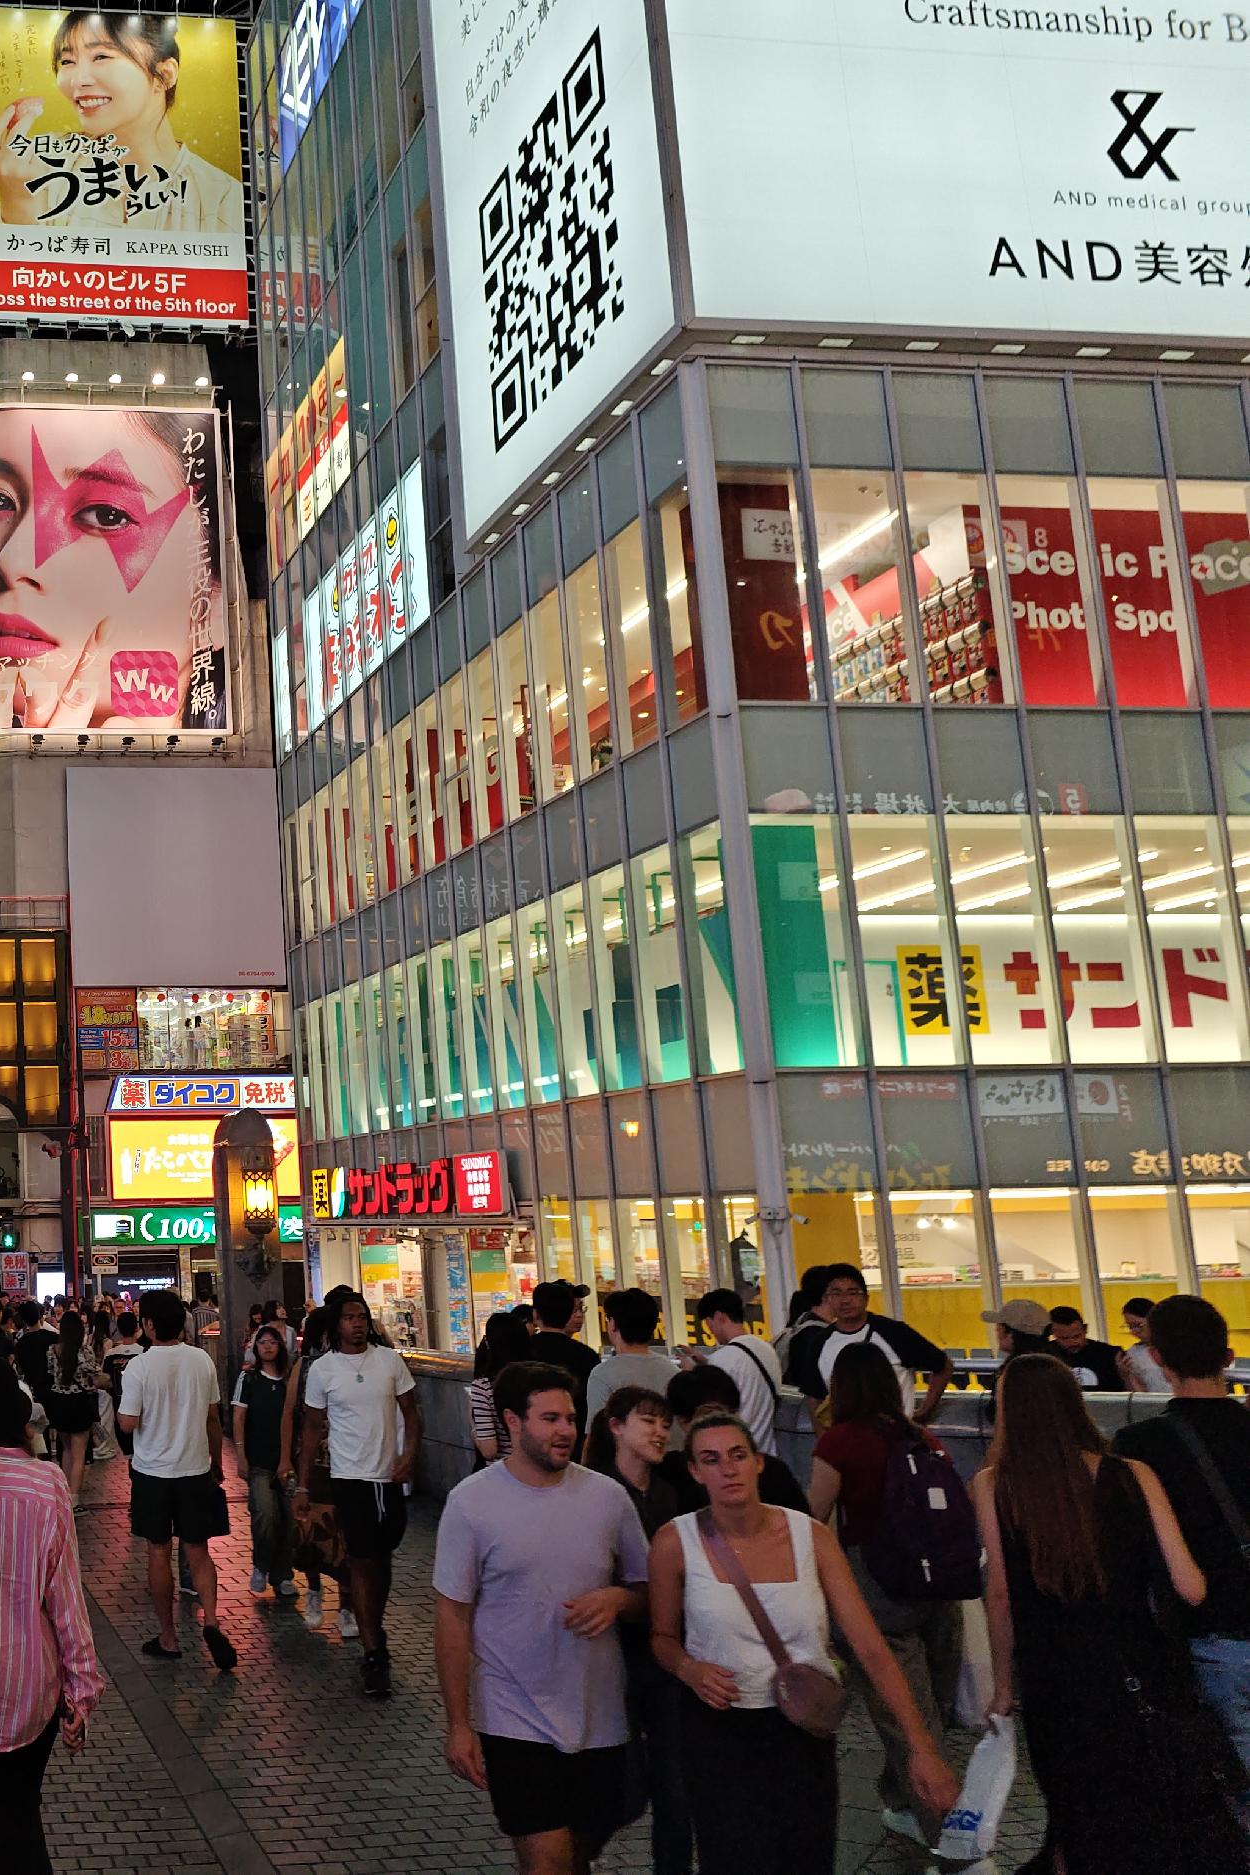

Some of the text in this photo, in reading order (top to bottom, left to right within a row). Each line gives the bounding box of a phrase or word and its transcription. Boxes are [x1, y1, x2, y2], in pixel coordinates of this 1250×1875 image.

[904, 0, 1250, 43] Craftsmanship for B
[8, 134, 127, 158] 今日もかっぱが
[1053, 190, 1097, 207] AND
[1107, 193, 1187, 212] medical
[6, 233, 230, 258] かっぱ寿司 KAPPA SUSHI
[989, 236, 1250, 288] AND美容
[29, 292, 56, 307] the
[59, 295, 110, 309] street
[113, 295, 132, 310] of
[135, 296, 163, 311] the
[165, 297, 192, 312] 5th
[195, 298, 237, 314] floor
[1005, 543, 1140, 578] Sceic
[1011, 601, 1177, 638] Phot Spo
[1004, 948, 1250, 1029] サンド
[121, 1079, 287, 1108] 薬 ダイコク 免税
[348, 1160, 450, 1216] サンドラッグ
